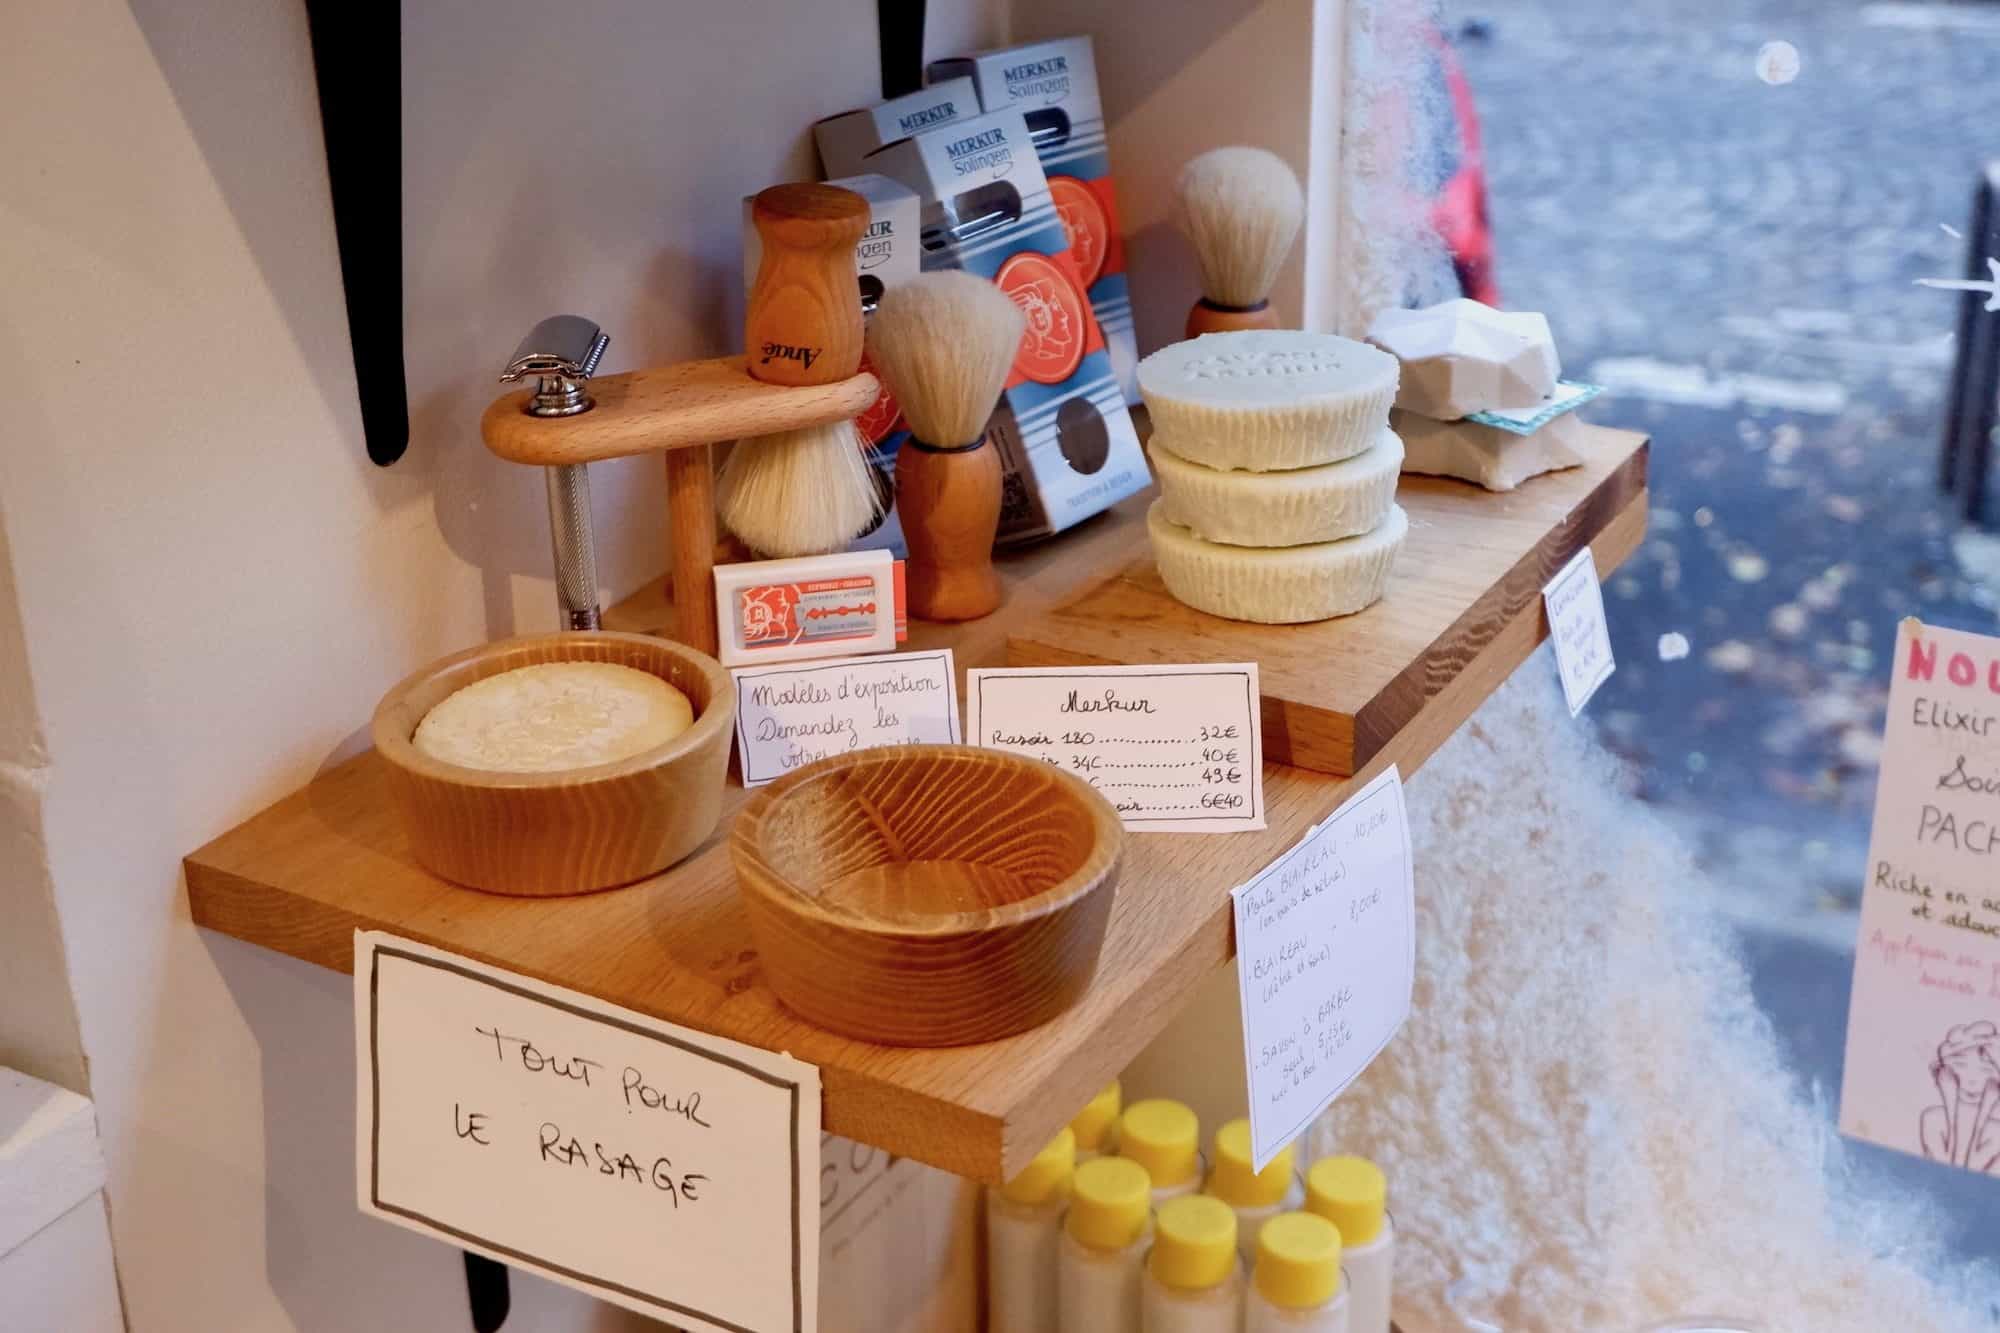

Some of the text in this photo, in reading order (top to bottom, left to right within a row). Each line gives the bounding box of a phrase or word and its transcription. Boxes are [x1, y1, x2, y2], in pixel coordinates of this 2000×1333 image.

[1004, 56, 1068, 83] MERKUR
[1008, 75, 1070, 102] Solingen
[899, 102, 958, 132] MERKUR
[945, 127, 1006, 157] MERKUR
[953, 148, 1013, 177] Solingen
[751, 669, 940, 709] Modèles d'exposition
[1060, 689, 1156, 714] Merkur
[756, 715, 858, 747] Demandez
[872, 706, 900, 729] les
[1913, 697, 1996, 736] Elixir
[992, 731, 1054, 746] Rasoir
[1200, 725, 1240, 741] 32€
[1072, 755, 1103, 772] 34C
[1202, 748, 1240, 763] 40€
[1201, 792, 1243, 809] 6€40
[1280, 840, 1338, 894] BLAIREAU
[1875, 860, 1934, 899] Riche
[1944, 891, 1968, 904] en
[1911, 900, 1931, 919] et
[1253, 935, 1307, 980] BLAIREAU
[1261, 1031, 1297, 1066] SAVON
[475, 1027, 712, 1128] TOUT POUR
[456, 1103, 712, 1209] LE RASAGE
